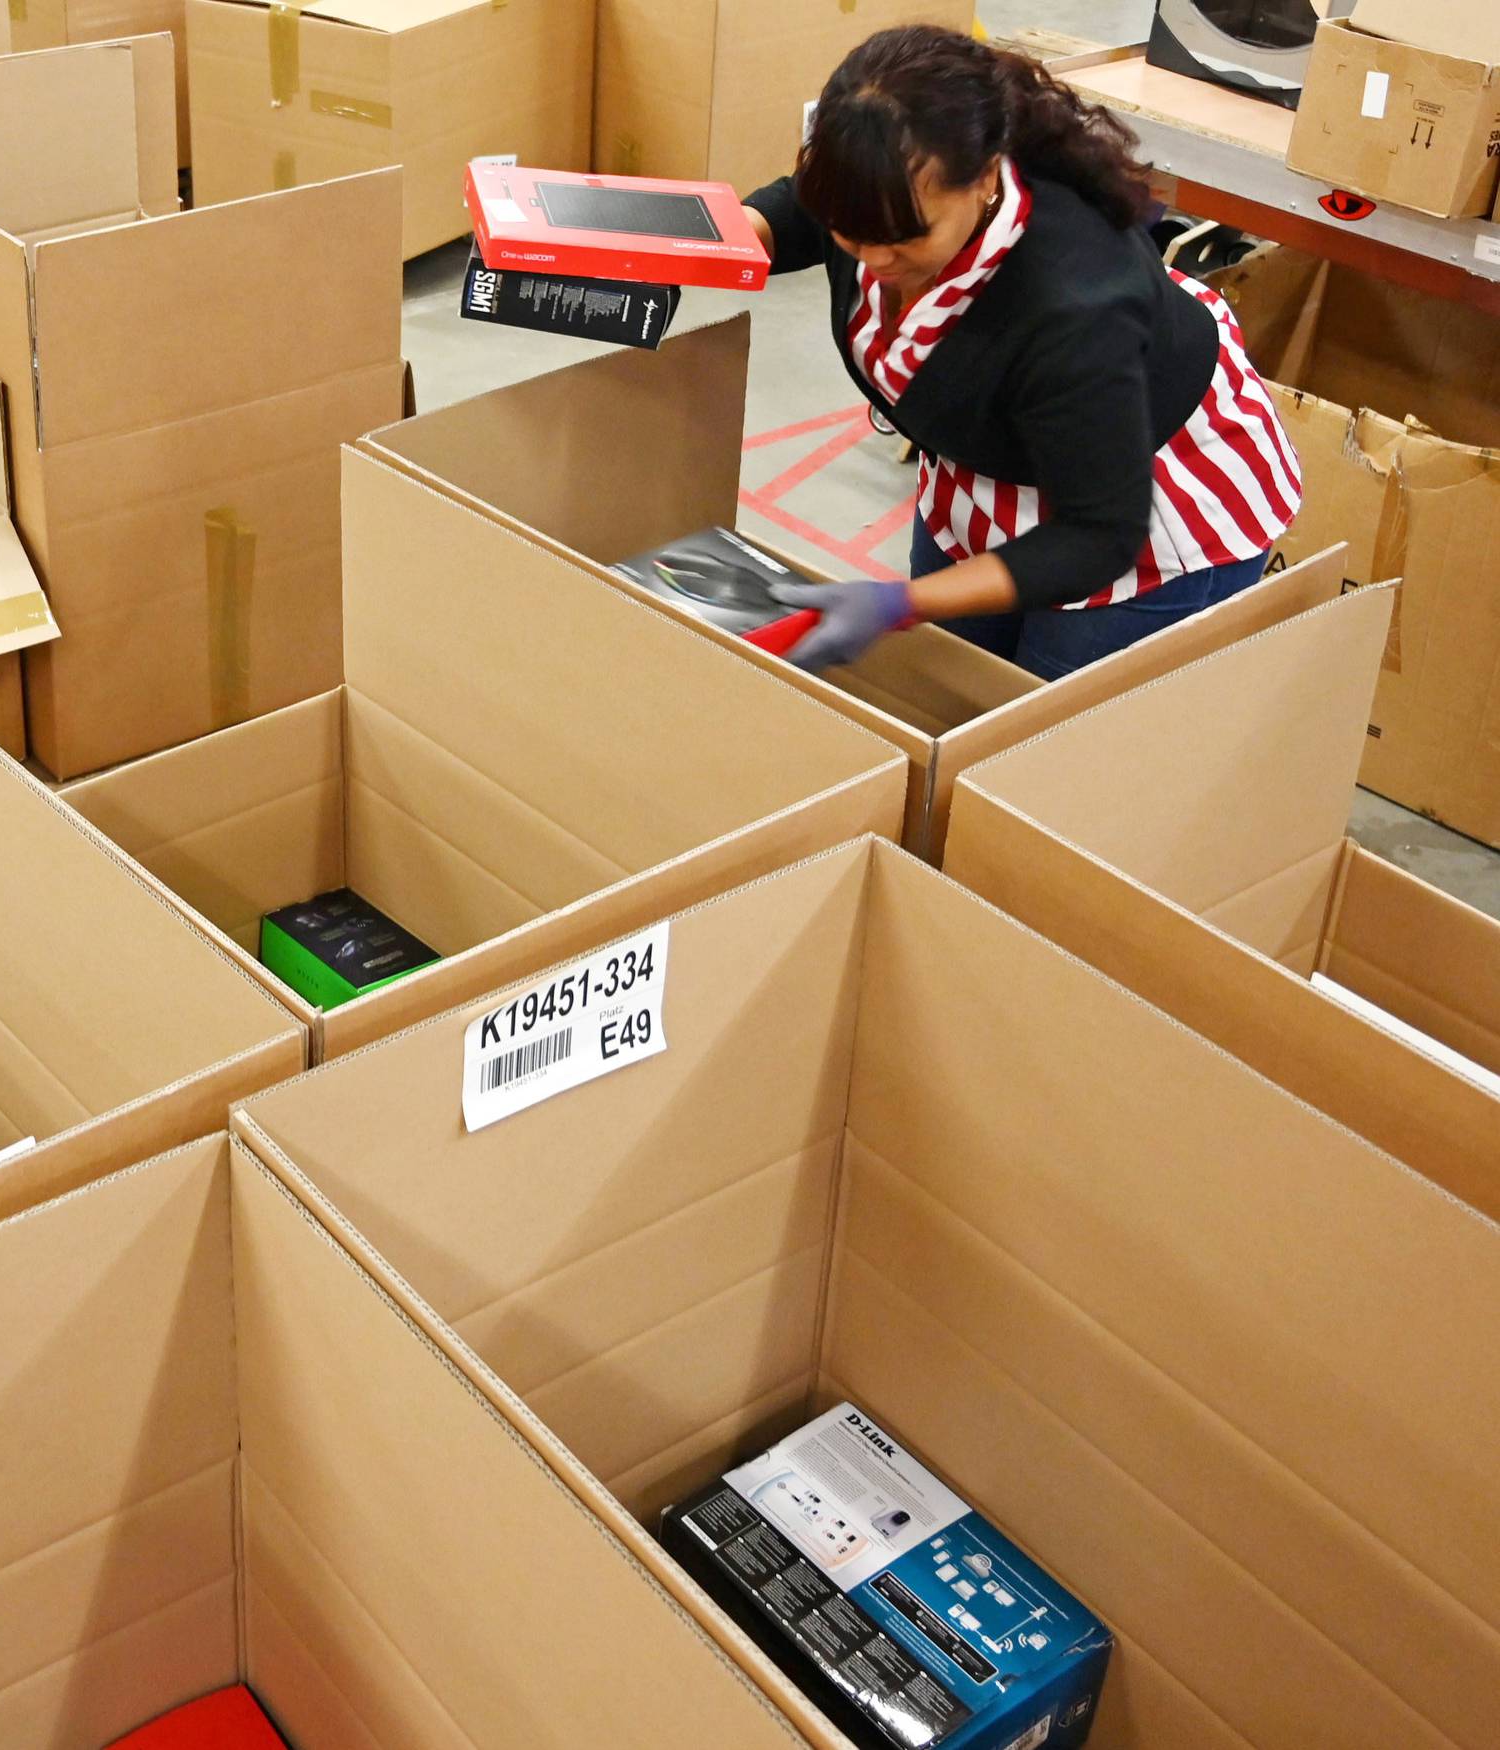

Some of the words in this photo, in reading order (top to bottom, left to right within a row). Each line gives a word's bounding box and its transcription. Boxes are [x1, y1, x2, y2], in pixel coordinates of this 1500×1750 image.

[469, 270, 496, 313] SGM1
[480, 942, 654, 1049] K19451-334
[599, 1004, 625, 1022] Platz
[600, 1008, 652, 1060] E49
[845, 1413, 897, 1458] D-Link
